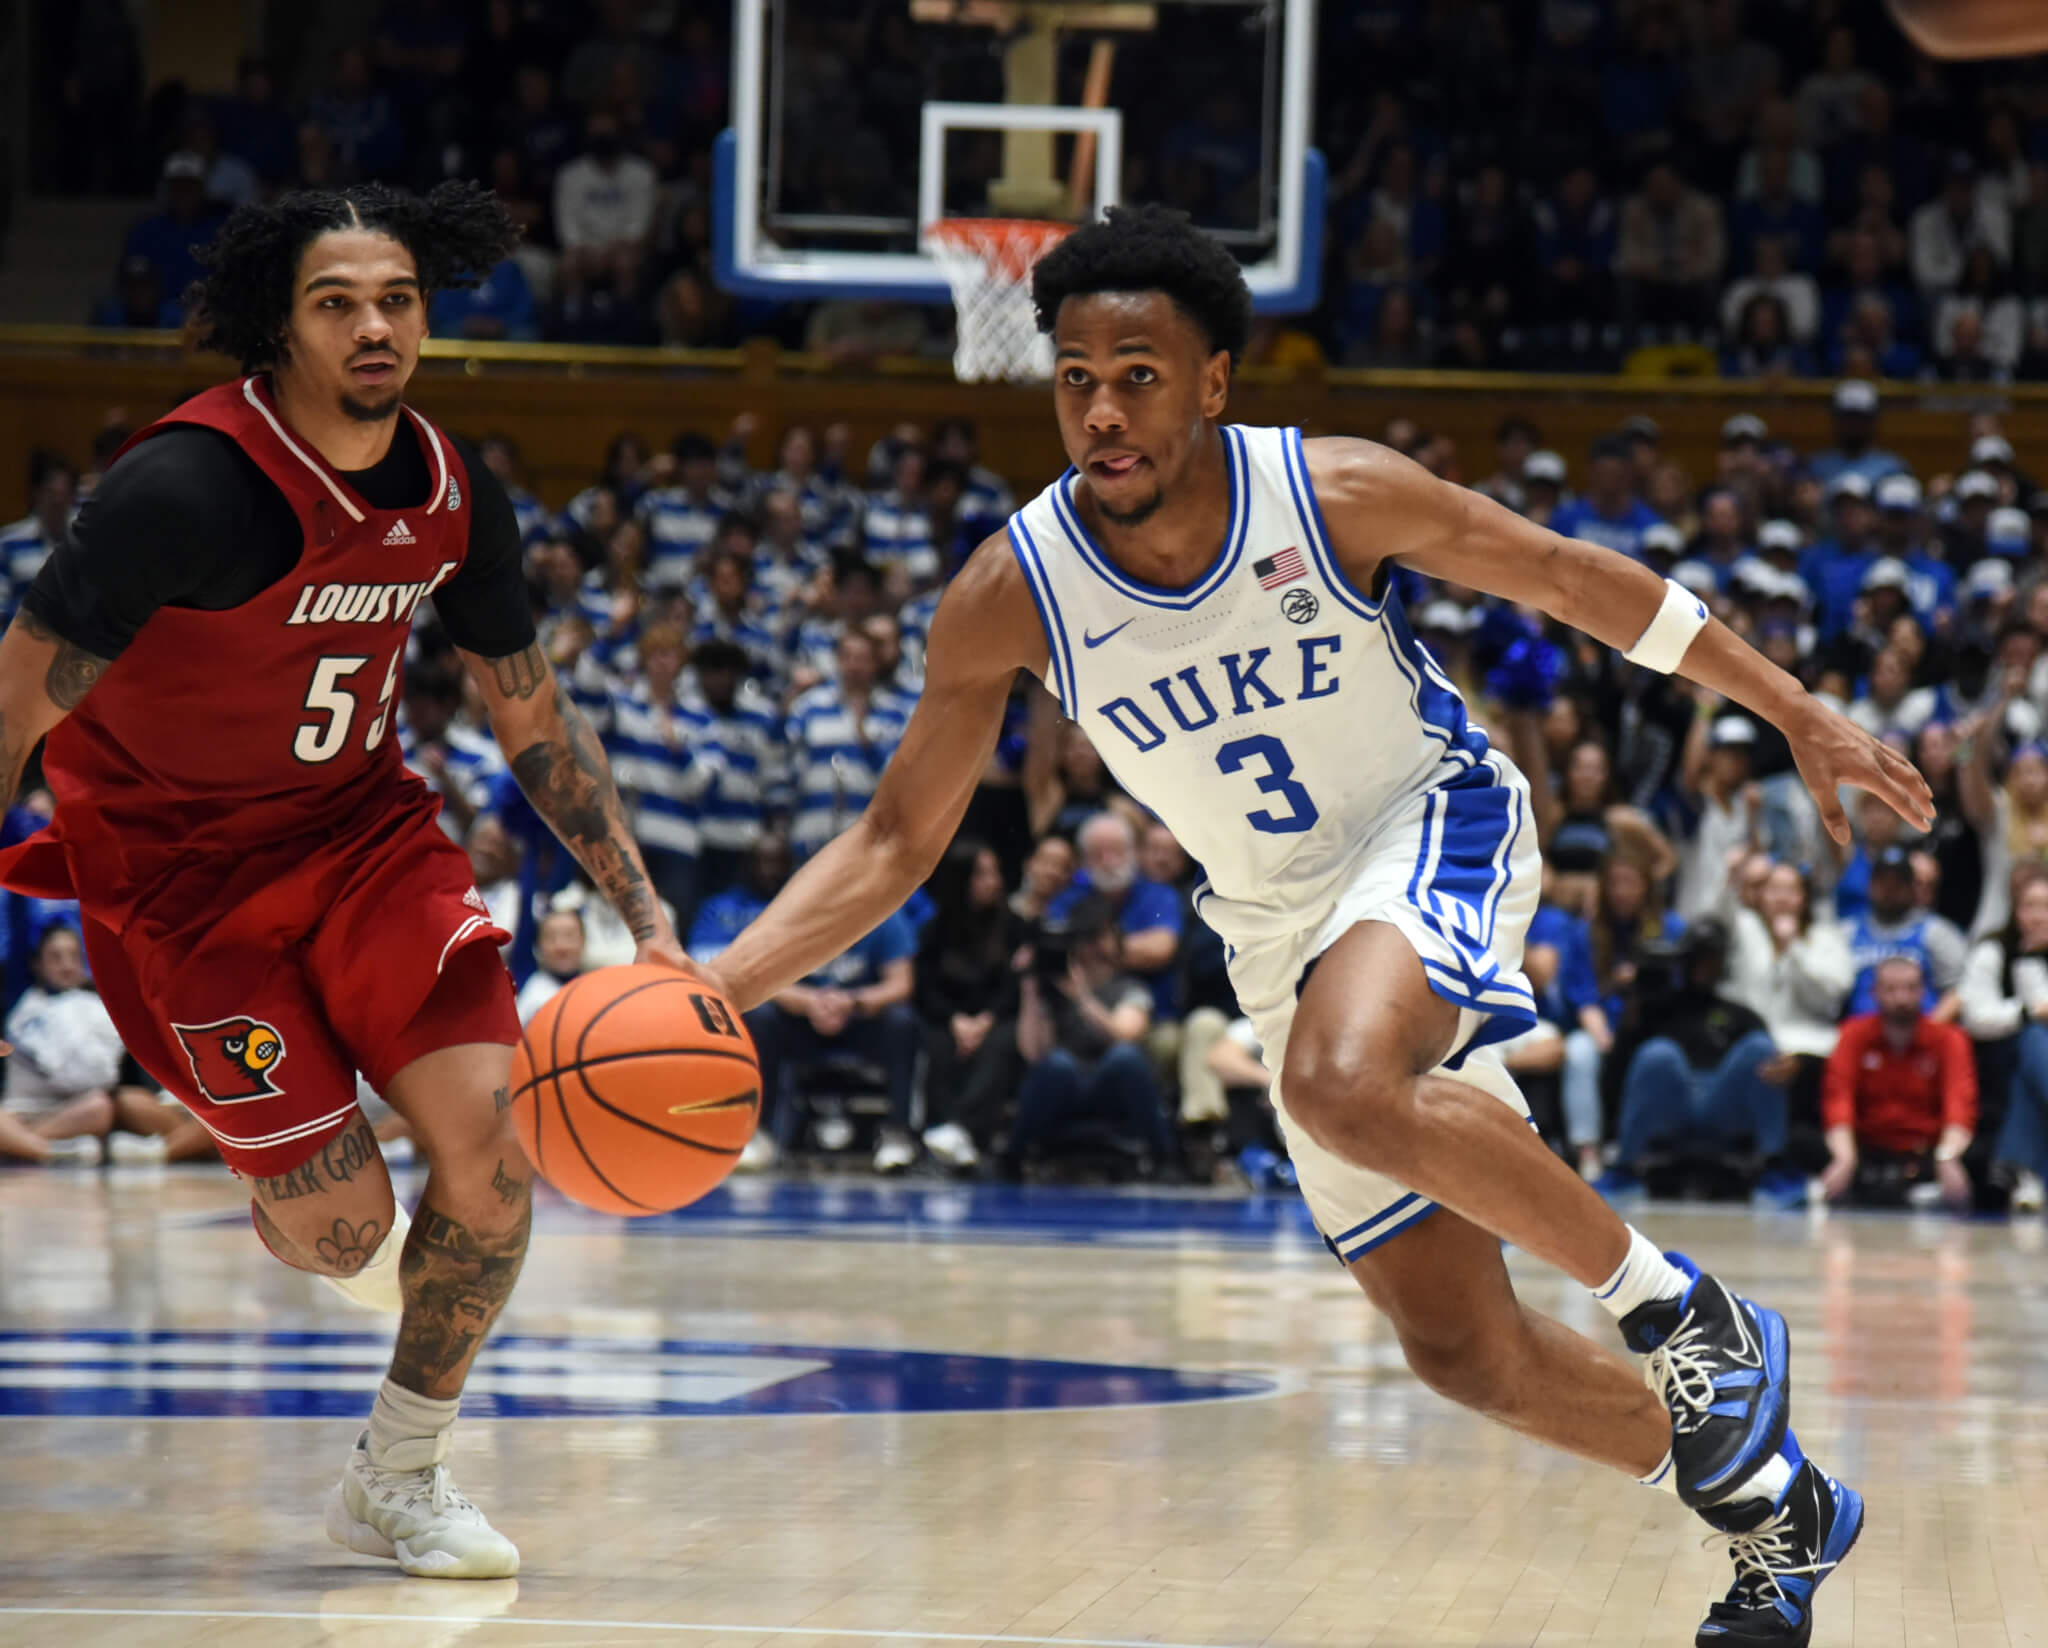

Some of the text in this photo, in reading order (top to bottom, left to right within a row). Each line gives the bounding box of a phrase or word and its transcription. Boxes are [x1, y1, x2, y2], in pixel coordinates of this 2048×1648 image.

[382, 535, 417, 546] adidas
[1097, 634, 1341, 753] DUKE
[1215, 733, 1320, 834] 3
[323, 1123, 377, 1183] GOD
